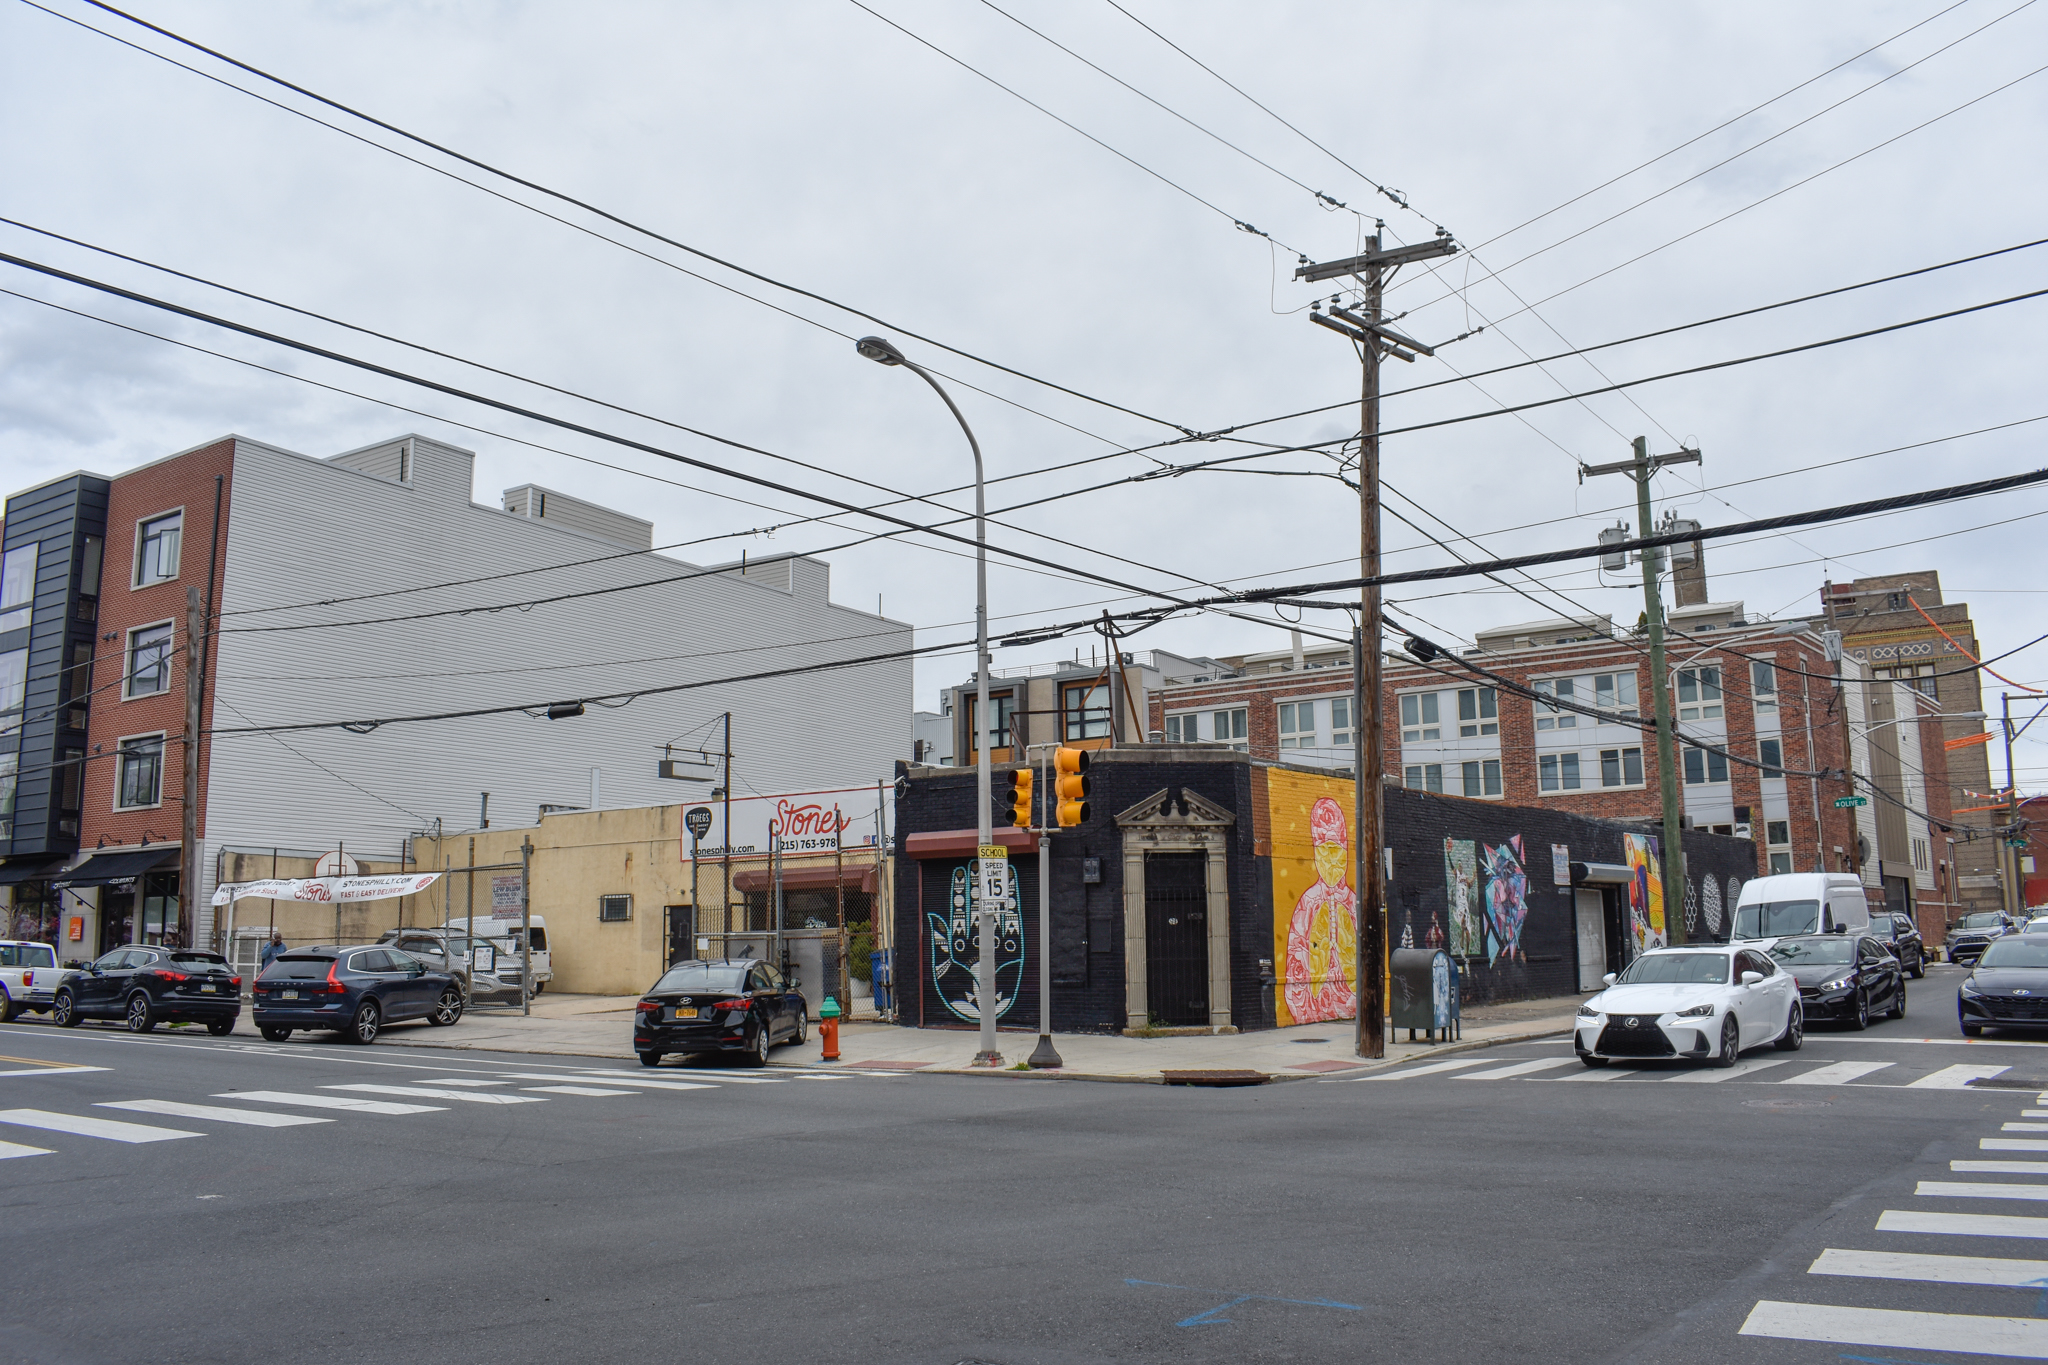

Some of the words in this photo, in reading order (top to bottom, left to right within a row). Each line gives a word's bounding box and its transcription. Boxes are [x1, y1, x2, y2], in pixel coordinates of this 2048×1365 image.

[801, 838, 837, 849] 763-978
[980, 848, 1005, 858] SCHOOL
[342, 876, 413, 888] STONESPHILLY.COM
[988, 878, 1002, 897] 15
[340, 891, 355, 899] FAST
[361, 889, 376, 898] EASY
[376, 886, 406, 896] DELIVERY
